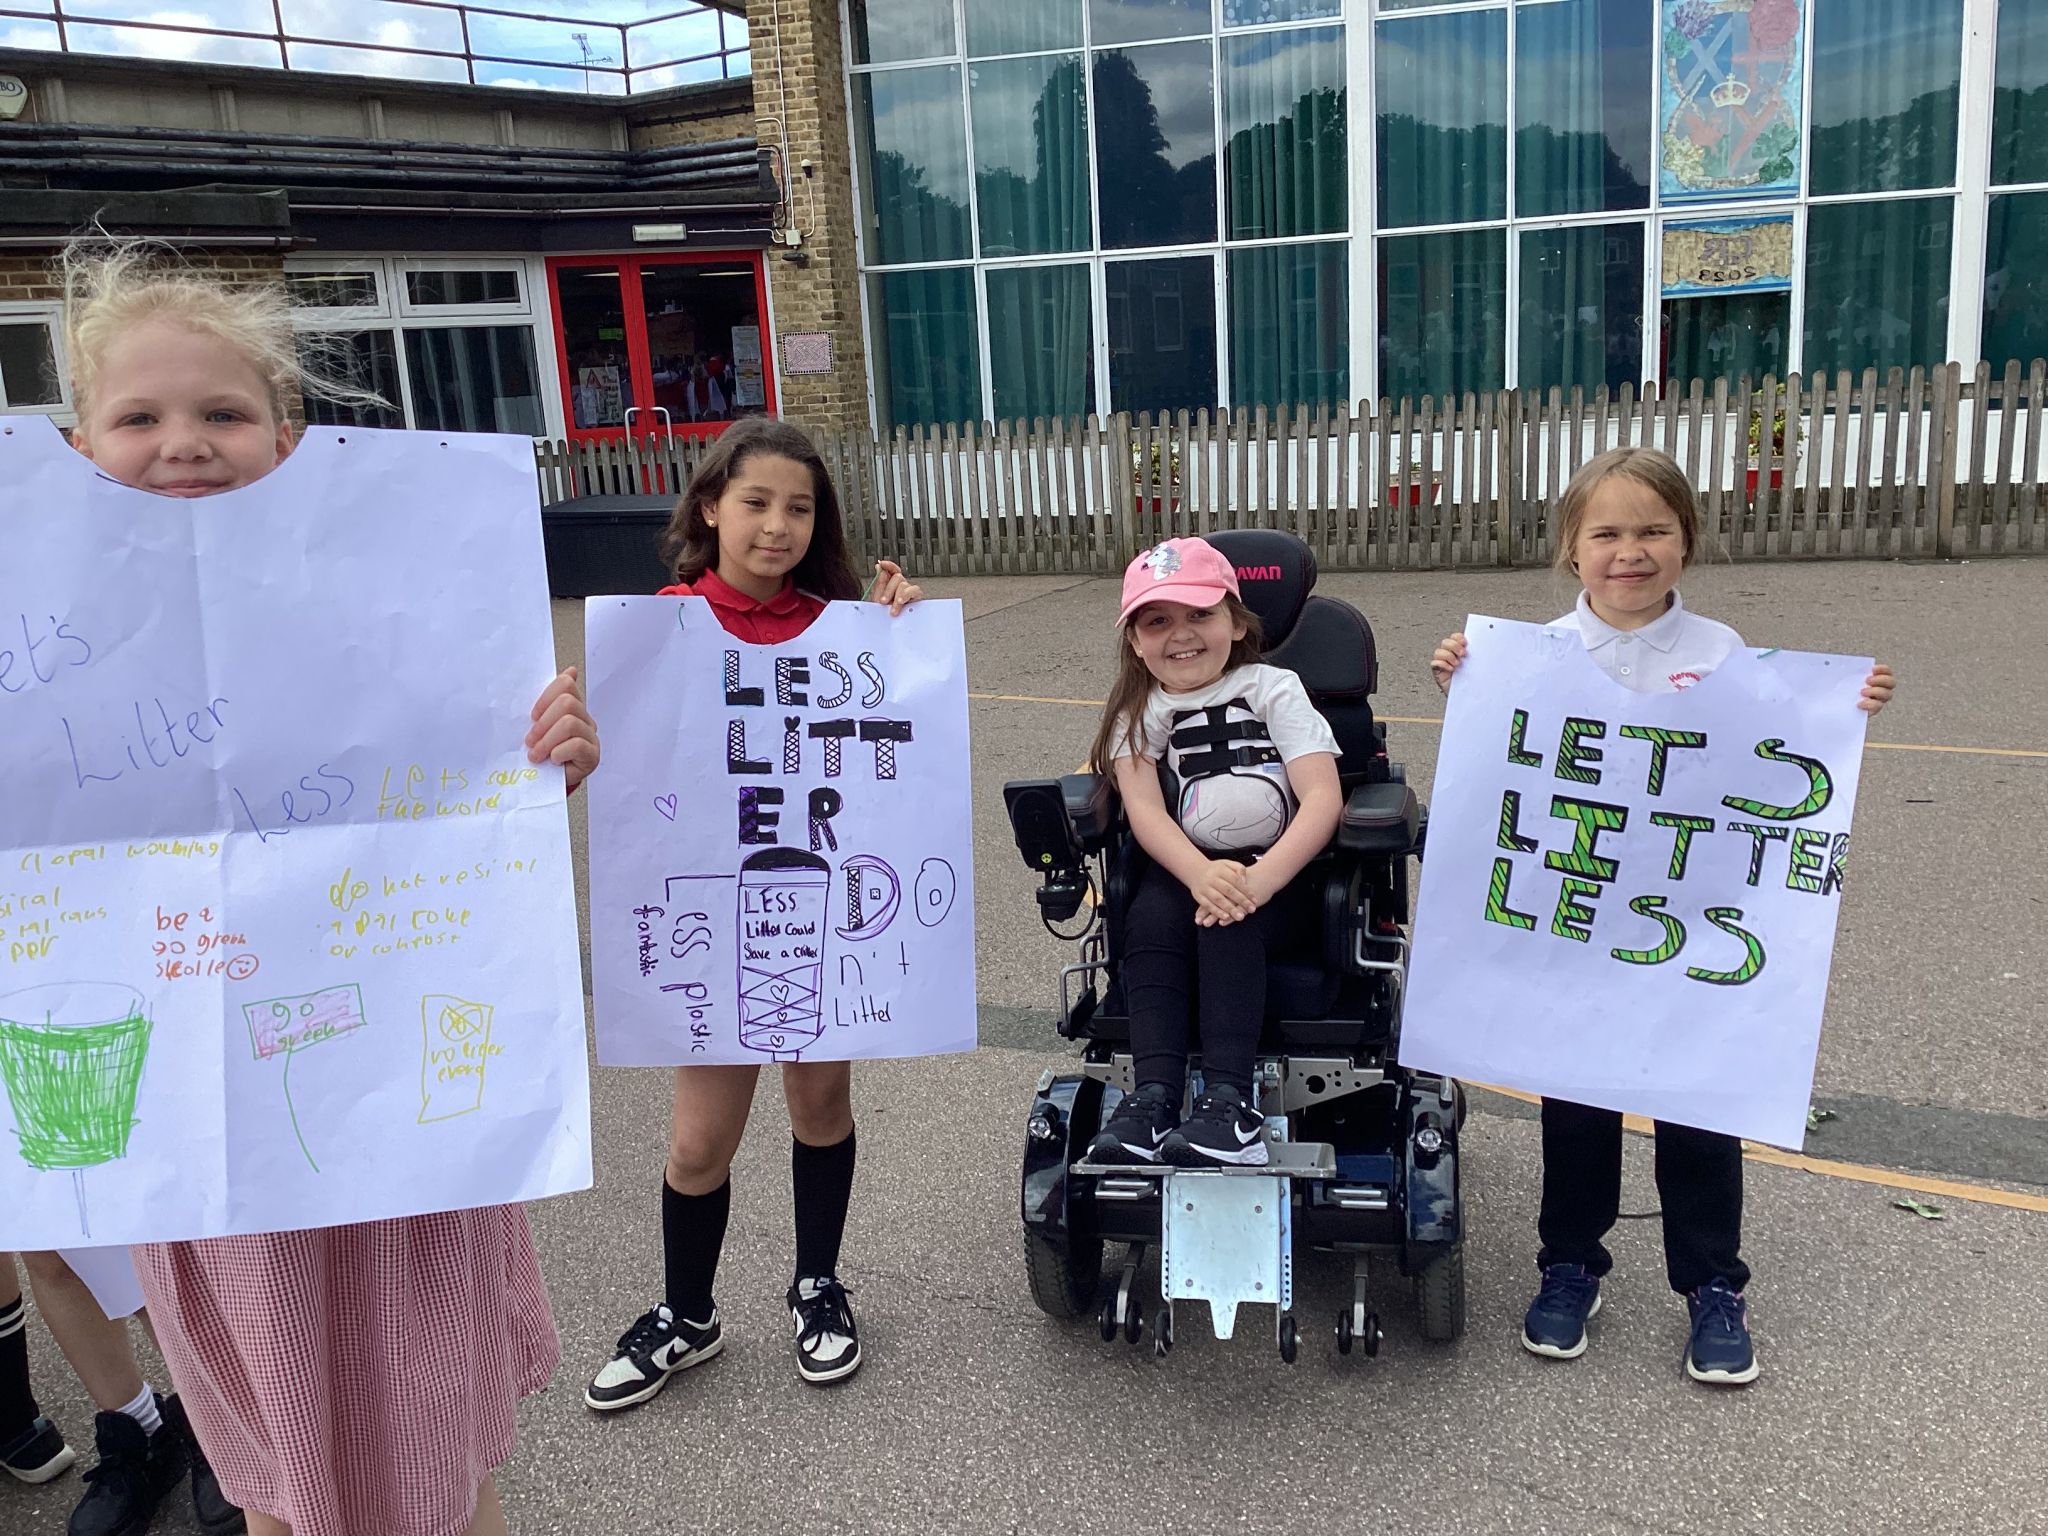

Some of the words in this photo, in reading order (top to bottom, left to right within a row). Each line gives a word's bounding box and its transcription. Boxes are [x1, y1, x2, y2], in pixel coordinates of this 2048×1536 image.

[724, 650, 886, 708] LESS
[62, 697, 229, 789] Litter
[738, 785, 844, 852] ER
[156, 905, 189, 931] be
[744, 886, 799, 914] LESS
[1484, 857, 1767, 986] LESS
[780, 949, 790, 959] a
[834, 993, 892, 1027] Litter
